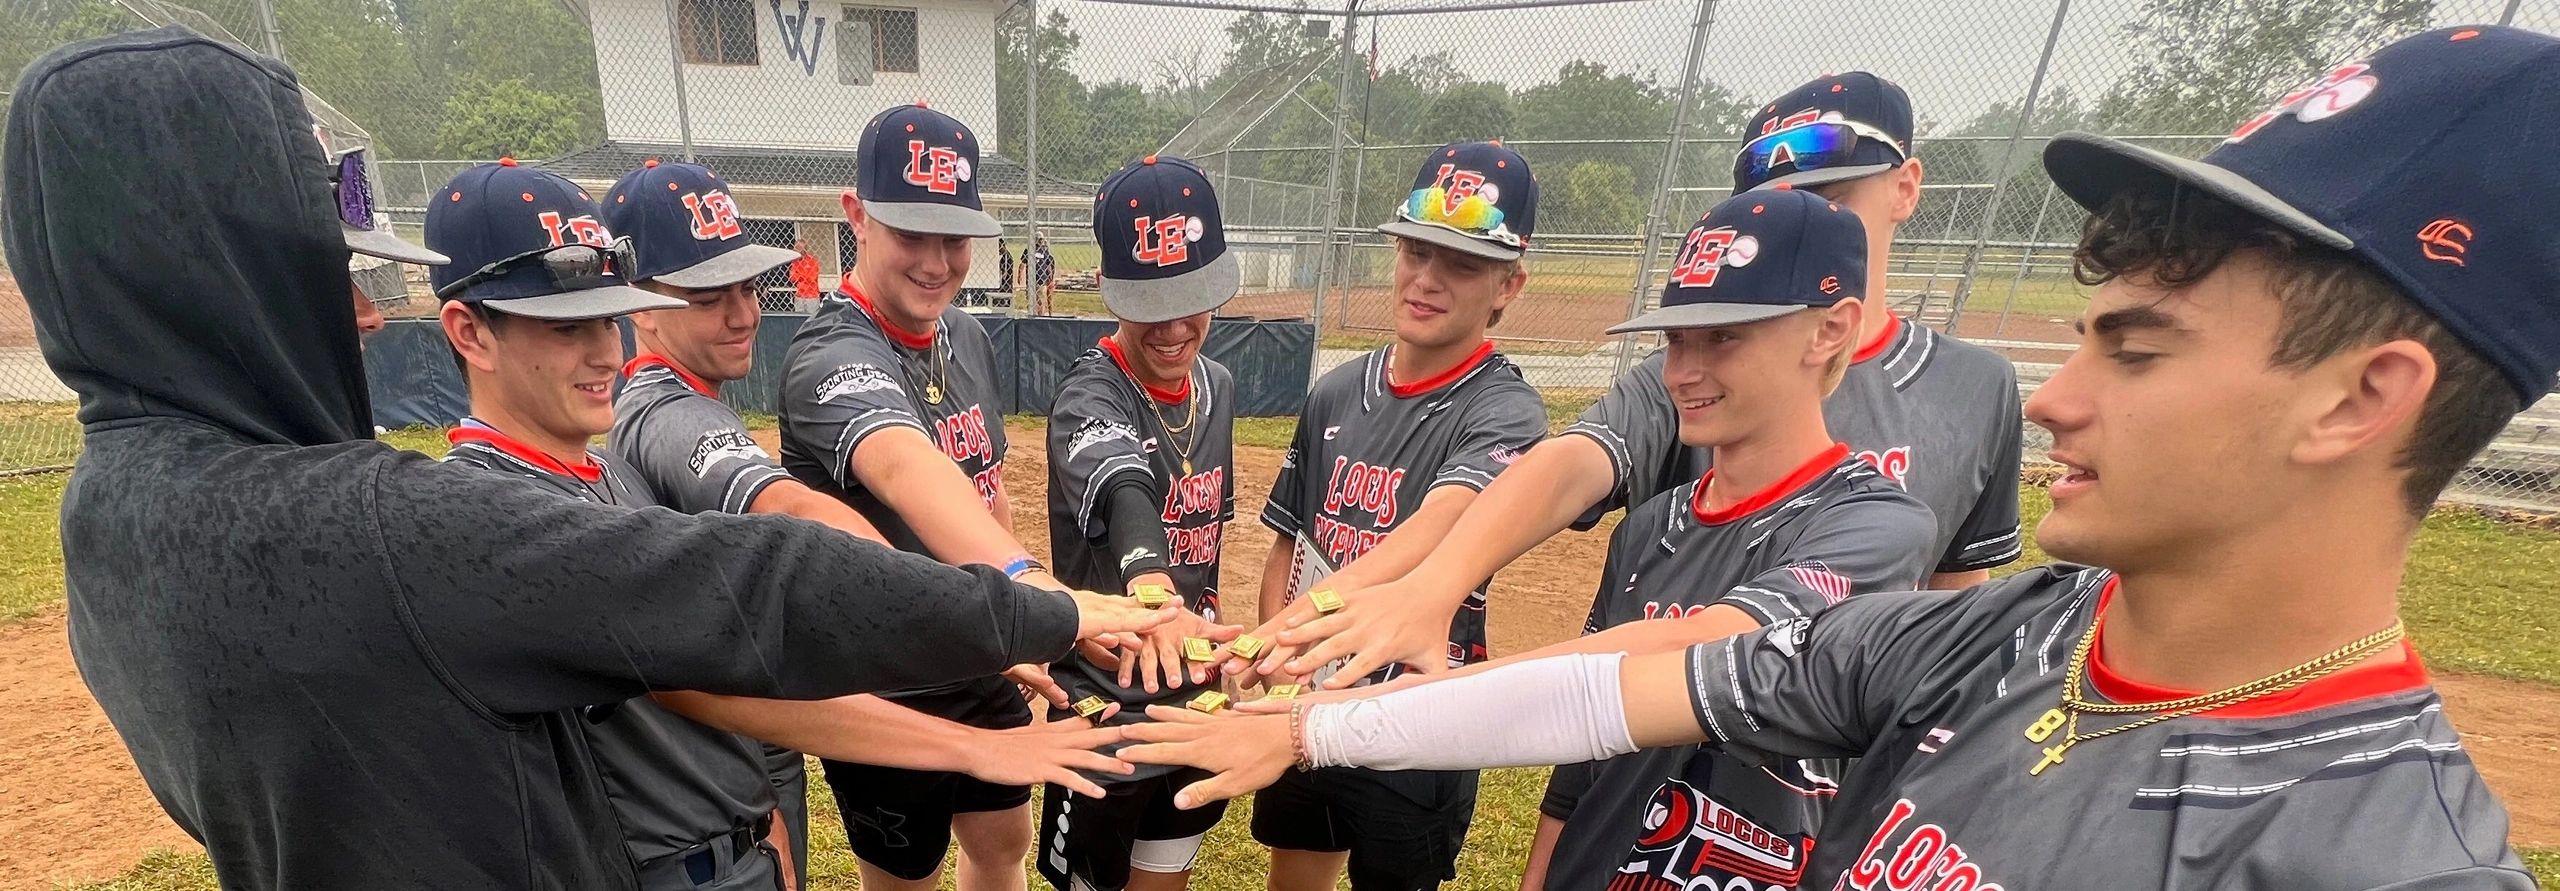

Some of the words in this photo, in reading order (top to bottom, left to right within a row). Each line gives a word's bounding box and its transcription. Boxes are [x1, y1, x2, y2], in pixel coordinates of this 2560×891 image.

[907, 139, 958, 196] LE
[681, 191, 742, 241] LE
[1134, 215, 1188, 267] LE
[1671, 225, 1738, 289] LE
[815, 367, 864, 400] SPORTING
[934, 403, 993, 467] OCOS
[1322, 455, 1406, 528] LOCOS
[2024, 708, 2067, 743] 8
[1701, 796, 1789, 858] LOCOS
[1850, 798, 2006, 891] LOC
